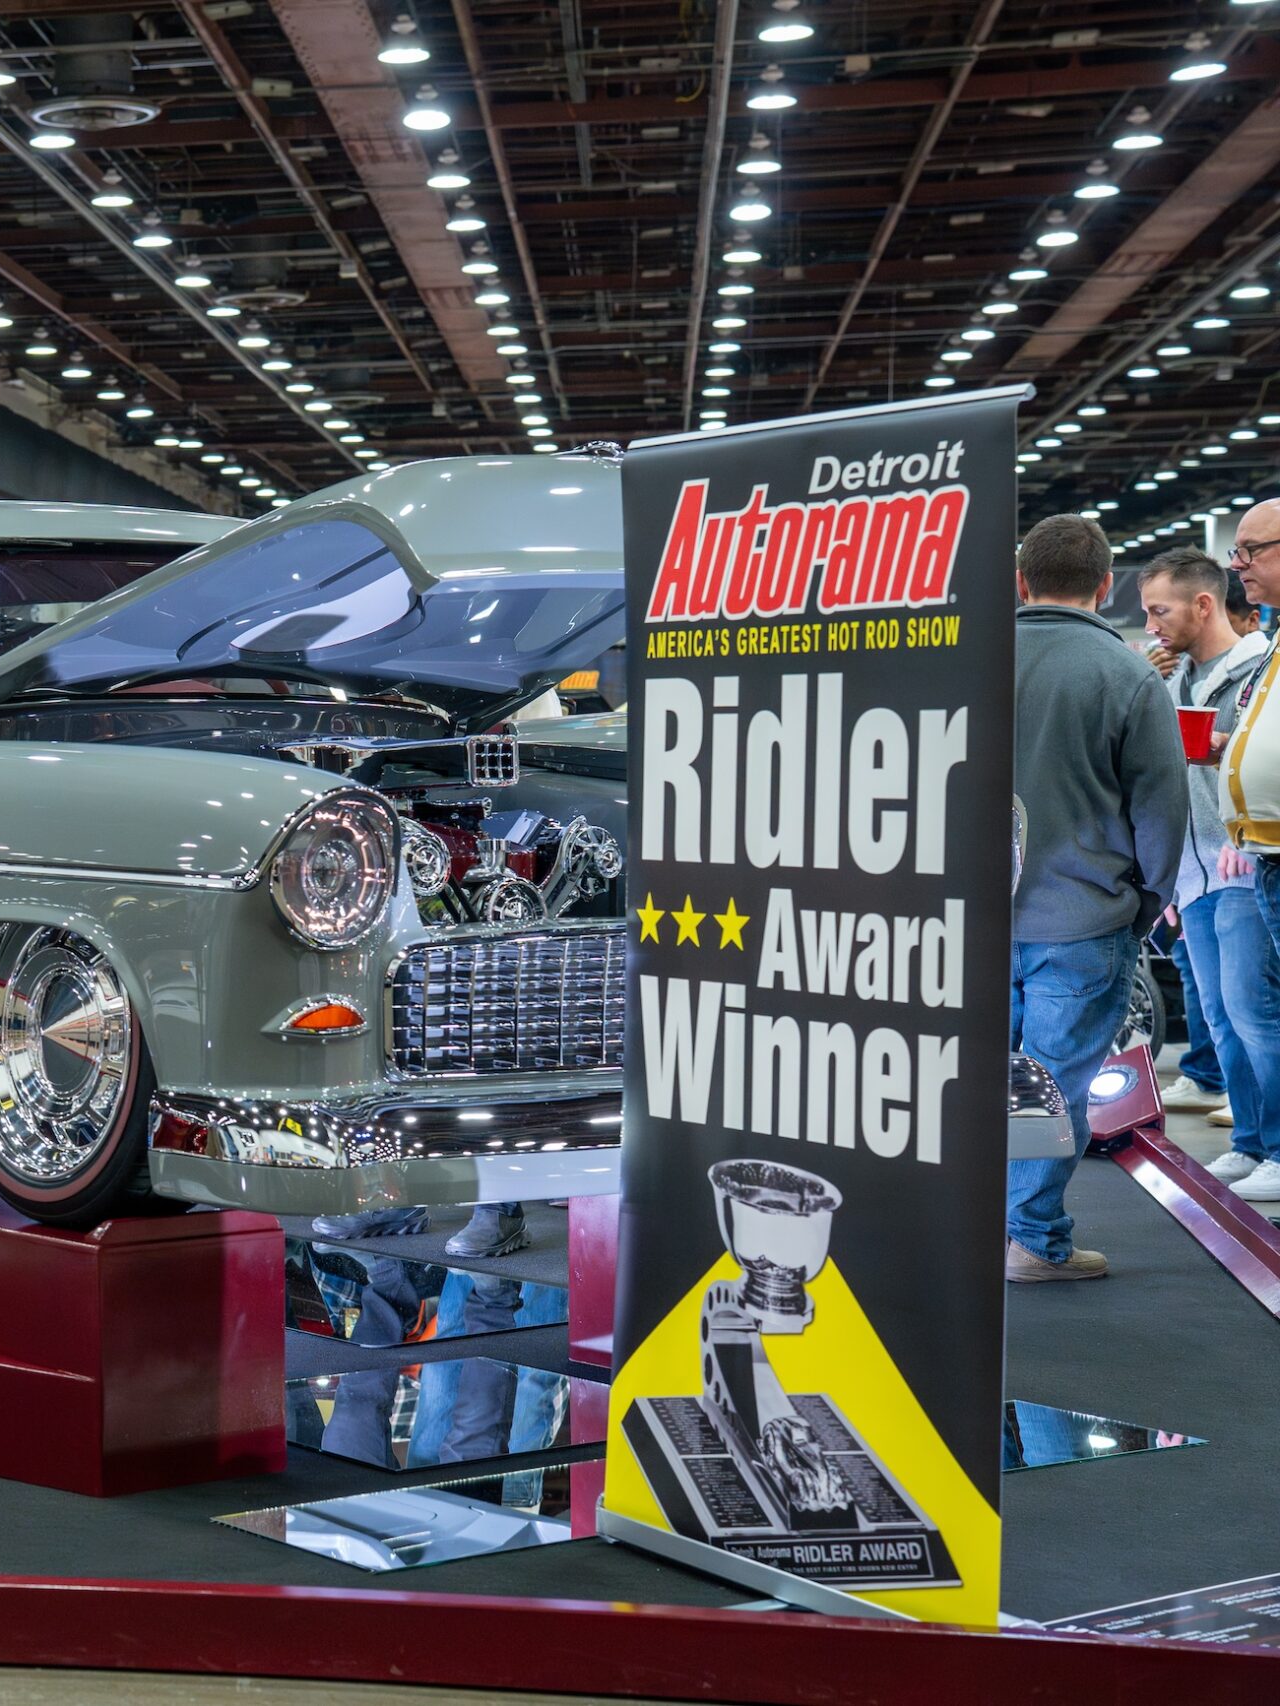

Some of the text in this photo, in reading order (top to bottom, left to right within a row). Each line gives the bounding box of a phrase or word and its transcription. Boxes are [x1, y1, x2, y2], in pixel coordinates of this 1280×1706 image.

[808, 441, 965, 495] Detroit
[645, 478, 970, 623] Autorama
[647, 616, 961, 659] AMERICA'S GREATEST HOT ROD SHOW
[641, 672, 968, 875] Ridler
[757, 888, 966, 1009] Award
[640, 975, 959, 1165] Winner
[757, 1546, 792, 1560] Autorama
[794, 1544, 855, 1564] RIDLER
[859, 1541, 922, 1561] AWARD
